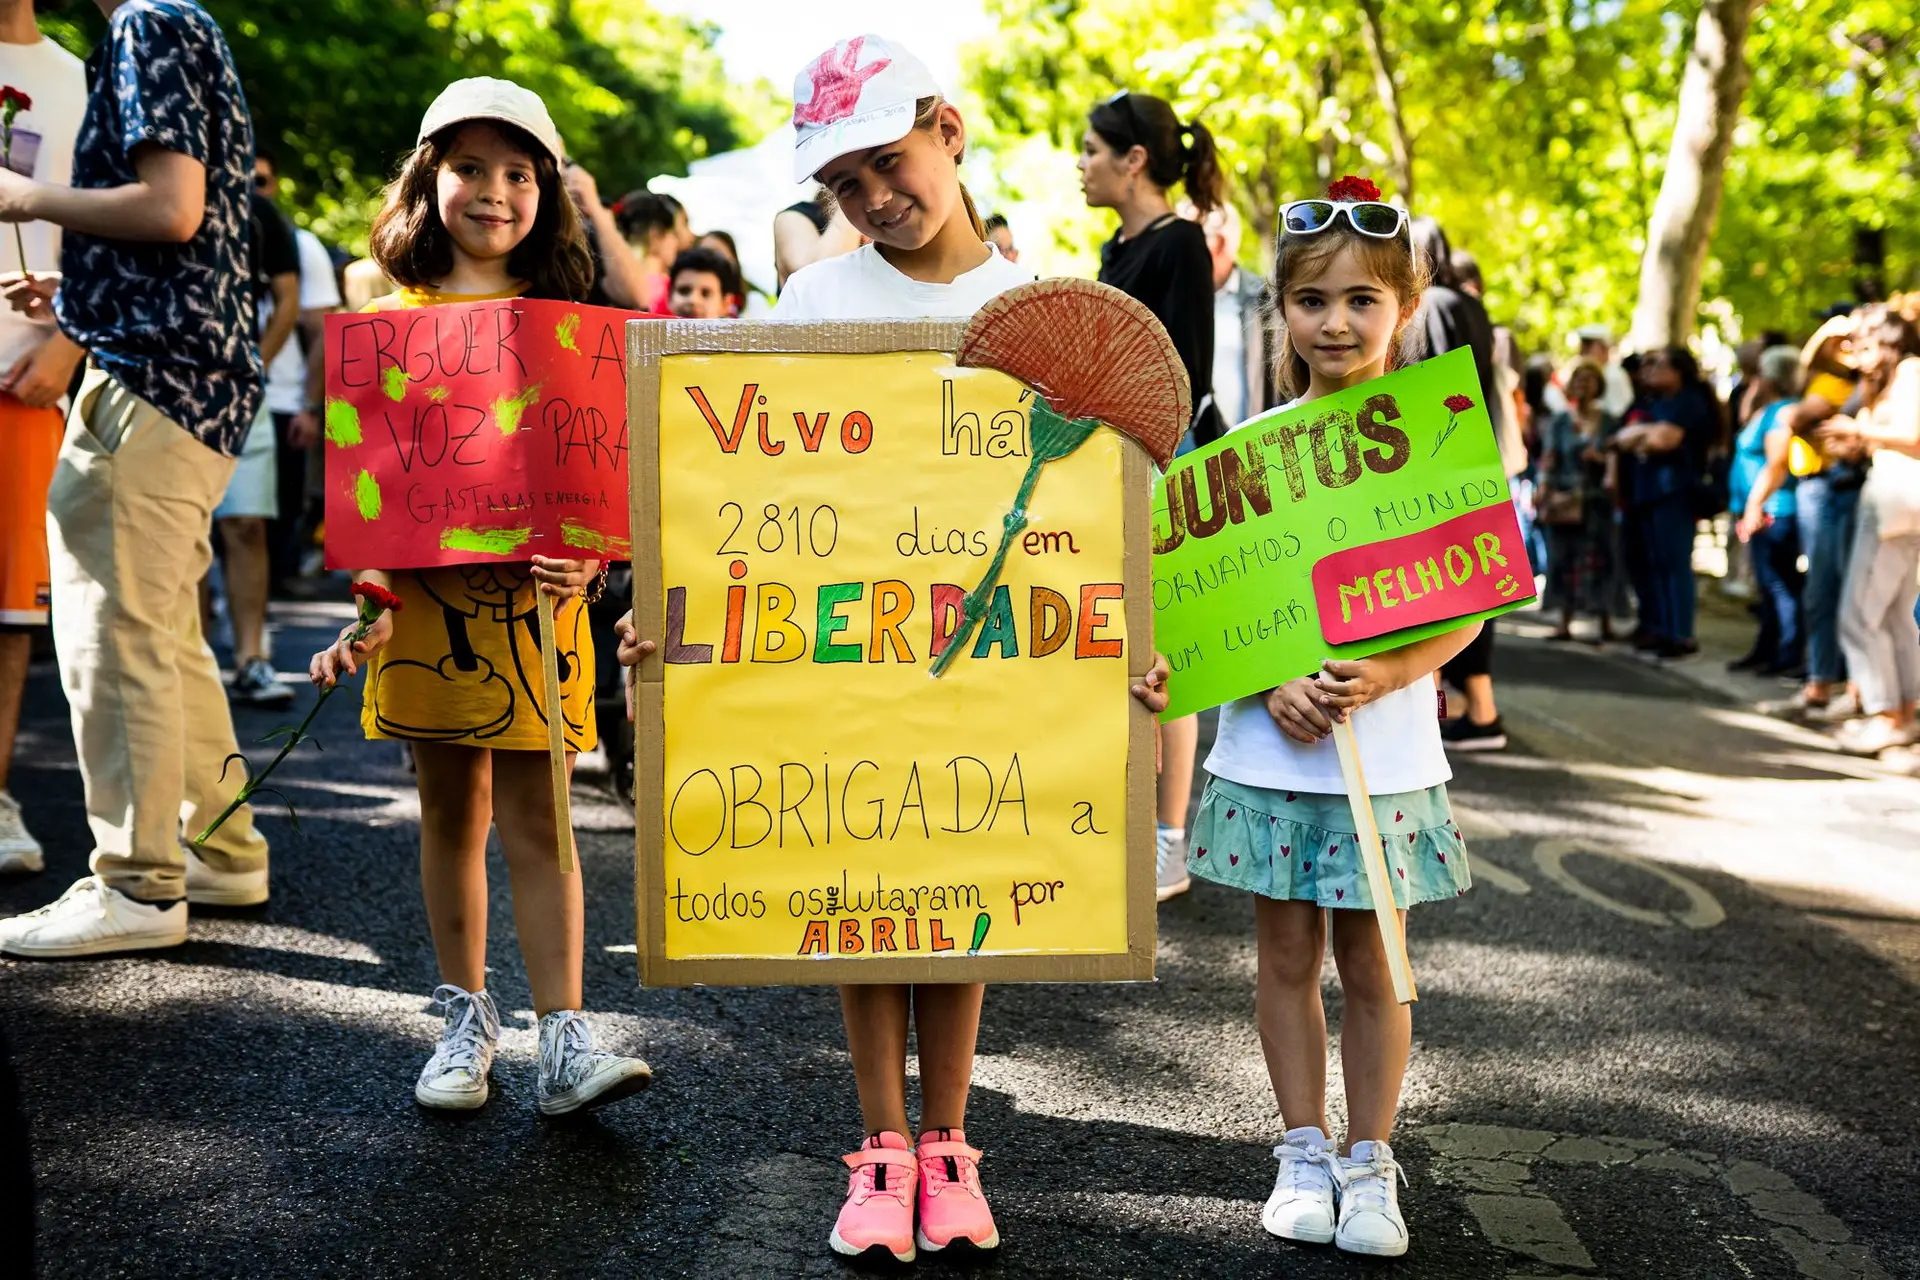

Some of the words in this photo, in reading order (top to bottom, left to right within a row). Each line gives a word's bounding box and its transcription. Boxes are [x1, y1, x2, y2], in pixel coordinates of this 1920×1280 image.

[341, 308, 527, 388] ERGUER
[591, 322, 627, 386] A
[384, 403, 486, 473] VOZ
[685, 383, 875, 457] Vivo
[942, 379, 1032, 459] há
[1152, 392, 1412, 556] JUNTOS
[716, 502, 839, 558] 2810
[896, 506, 989, 557] dias
[1022, 528, 1081, 557] em
[1152, 530, 1301, 611] ORNAMOS
[1327, 516, 1347, 543] O
[1373, 478, 1499, 532] MUNDO
[1167, 640, 1204, 673] UM
[1223, 598, 1308, 652] LUGAR
[1337, 532, 1509, 624] MELHOR
[1071, 800, 1109, 835] a
[669, 877, 766, 923] todos
[788, 888, 824, 918] os
[826, 886, 844, 917] que
[843, 869, 988, 913] lutaram
[1009, 877, 1065, 926] por
